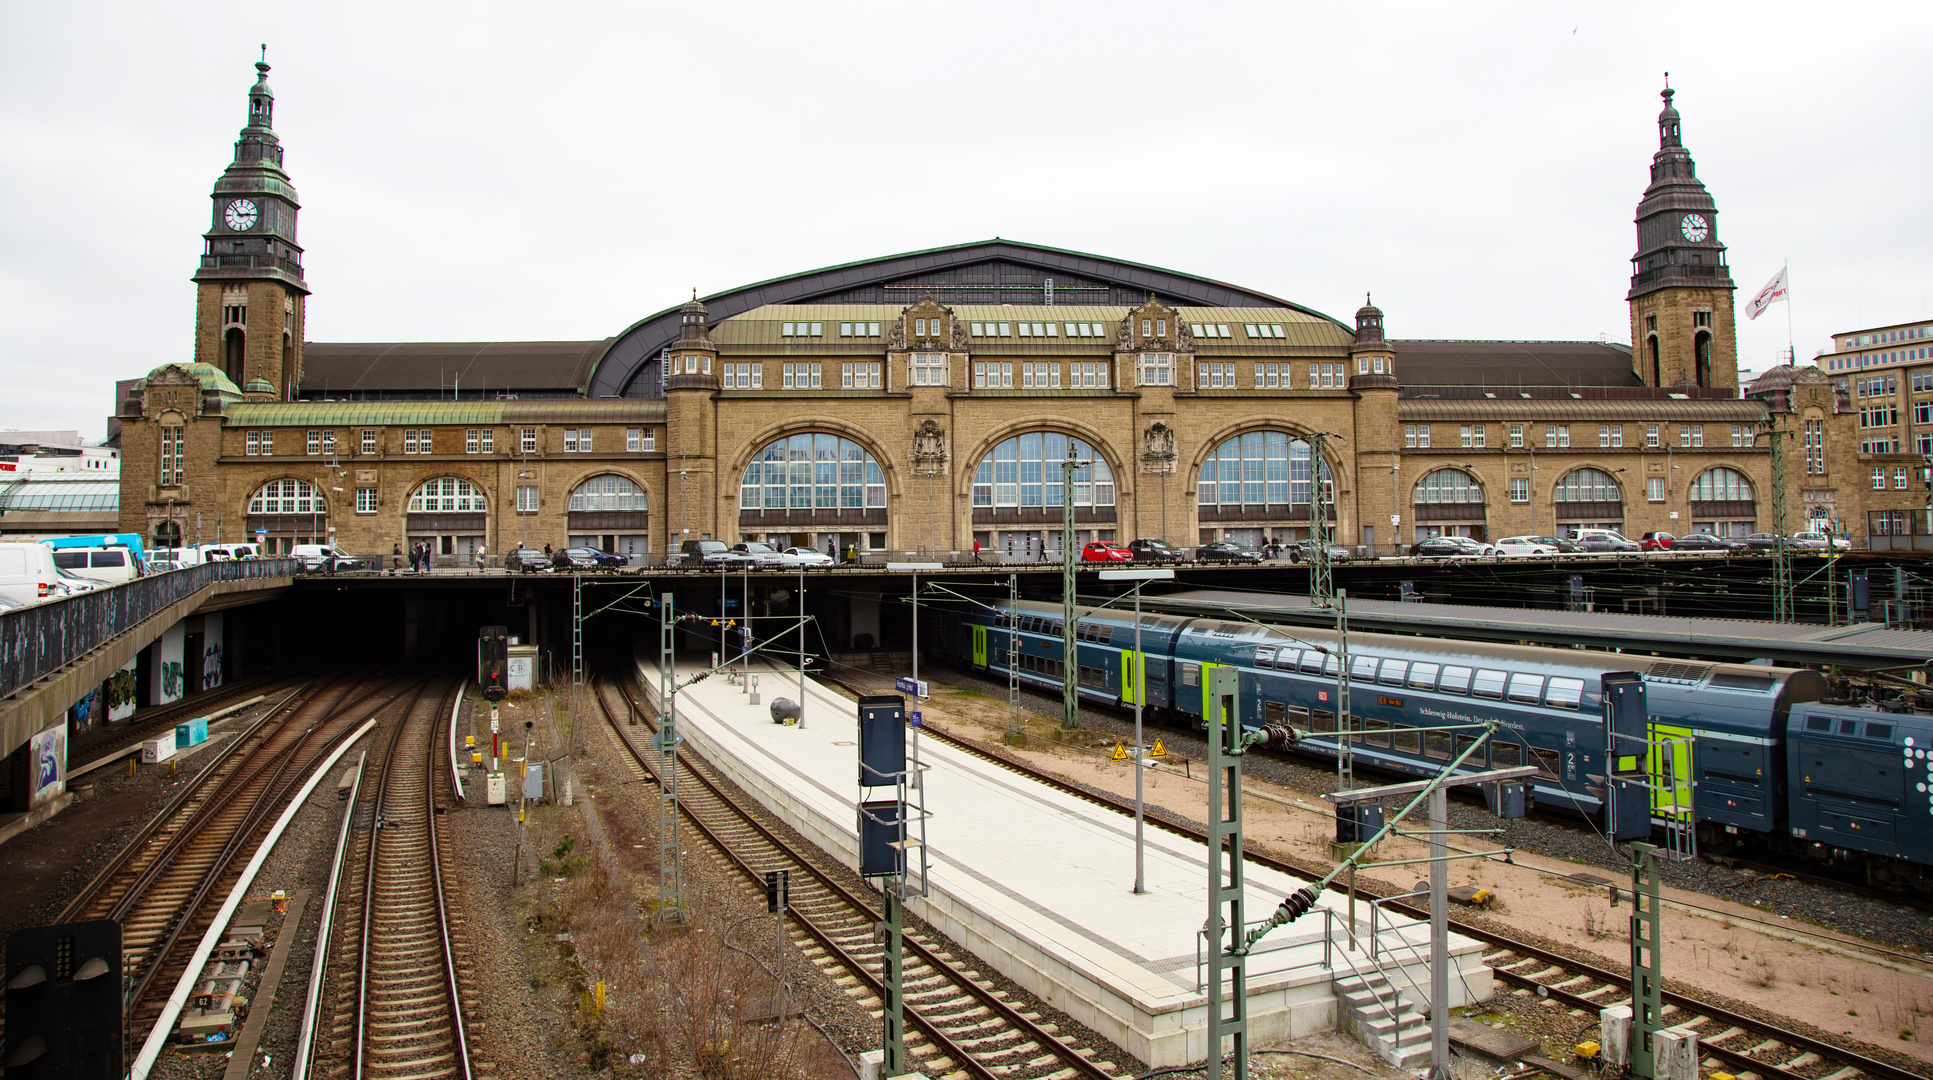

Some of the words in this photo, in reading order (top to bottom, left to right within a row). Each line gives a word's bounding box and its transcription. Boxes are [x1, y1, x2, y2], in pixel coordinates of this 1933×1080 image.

[1419, 707, 1472, 722] Schleswig-Holstein.
[1473, 715, 1484, 723] Der
[1567, 753, 1574, 764] 2
[199, 998, 208, 1006] 62
